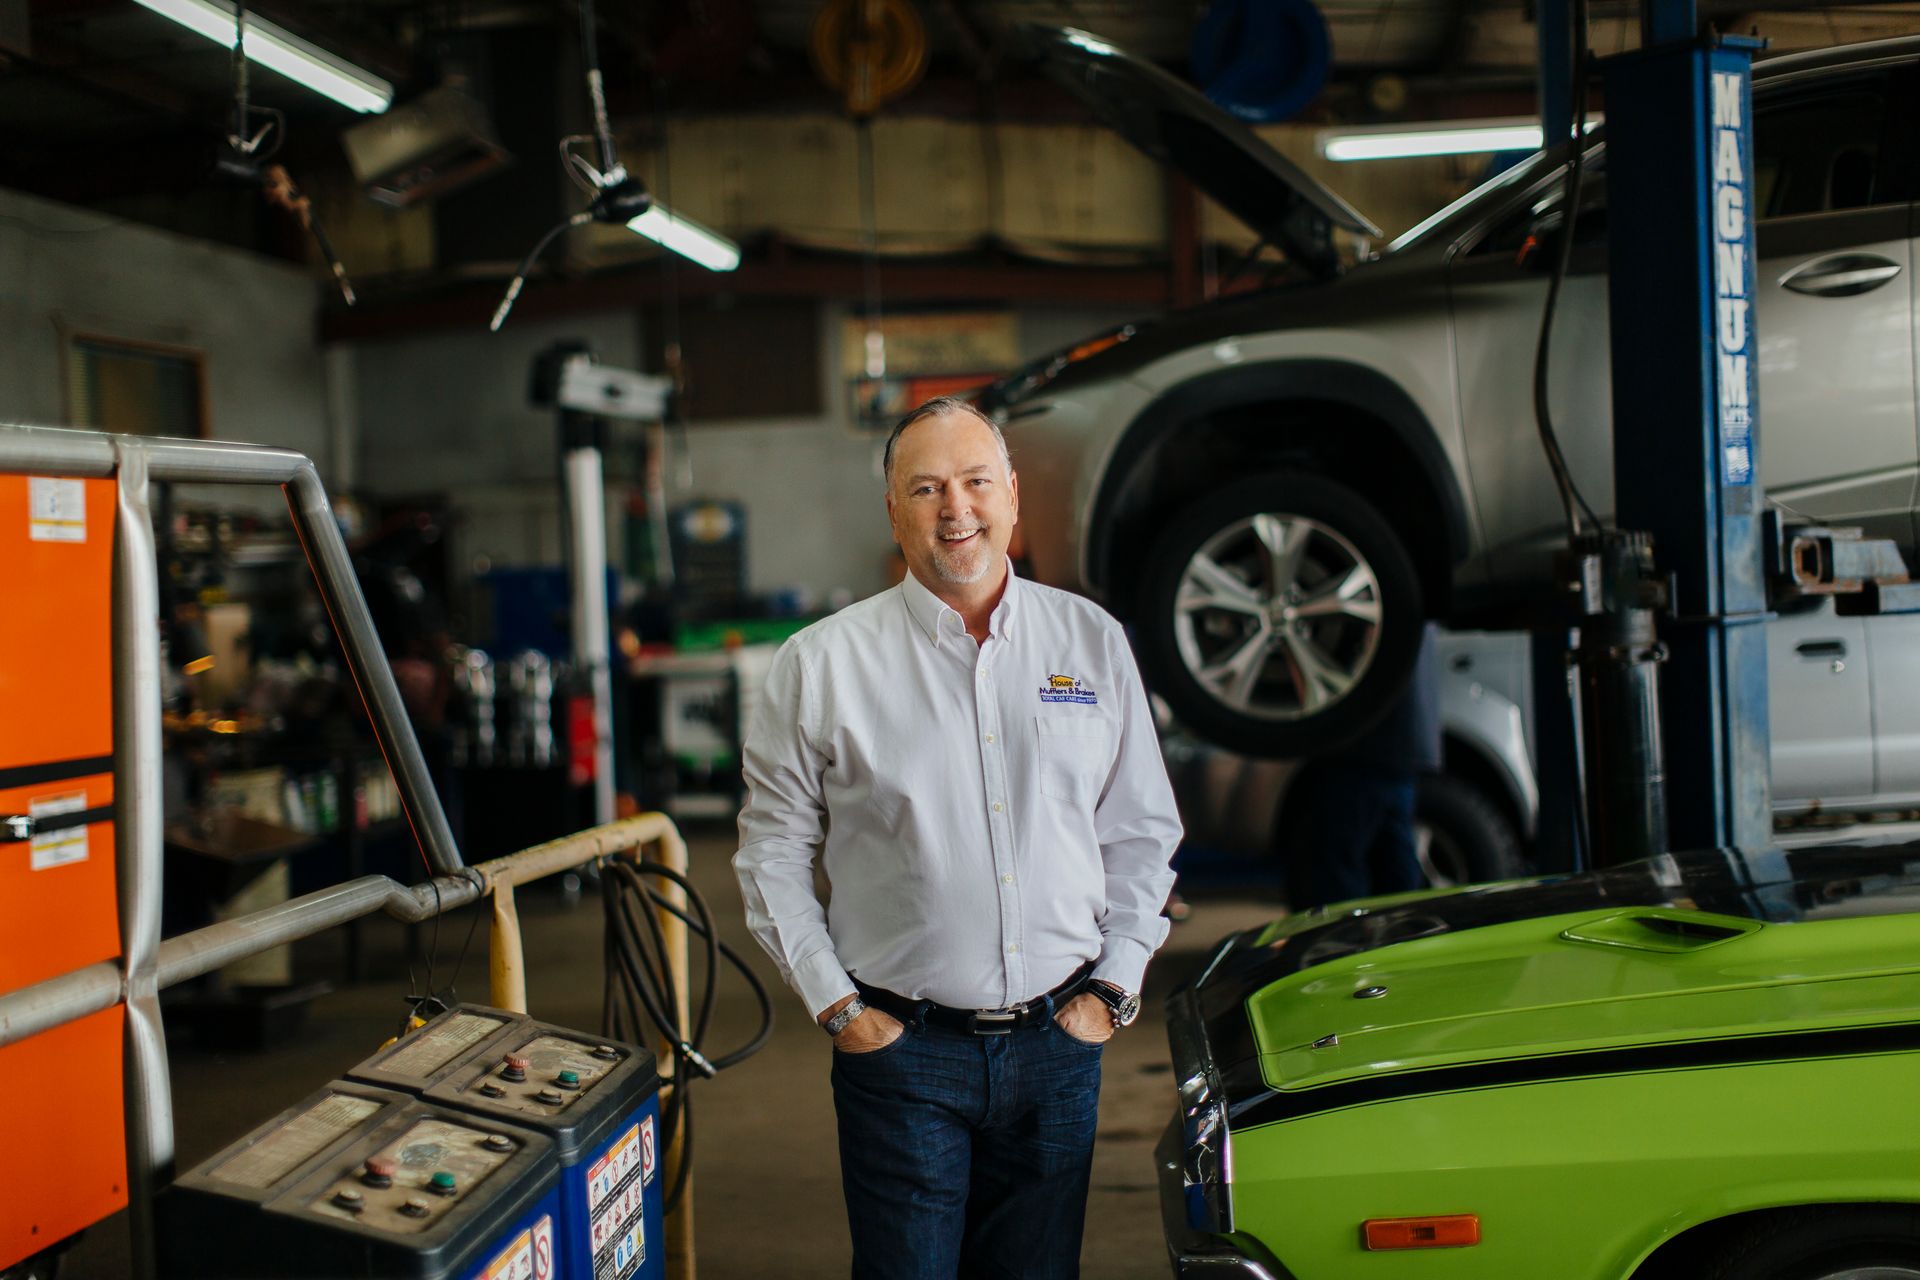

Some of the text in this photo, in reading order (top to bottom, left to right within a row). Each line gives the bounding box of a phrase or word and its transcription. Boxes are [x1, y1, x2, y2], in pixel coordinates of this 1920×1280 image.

[1712, 73, 1748, 406] MAGNUM
[1050, 679, 1073, 687] House
[1039, 687, 1095, 696] Mufflers & Brakes
